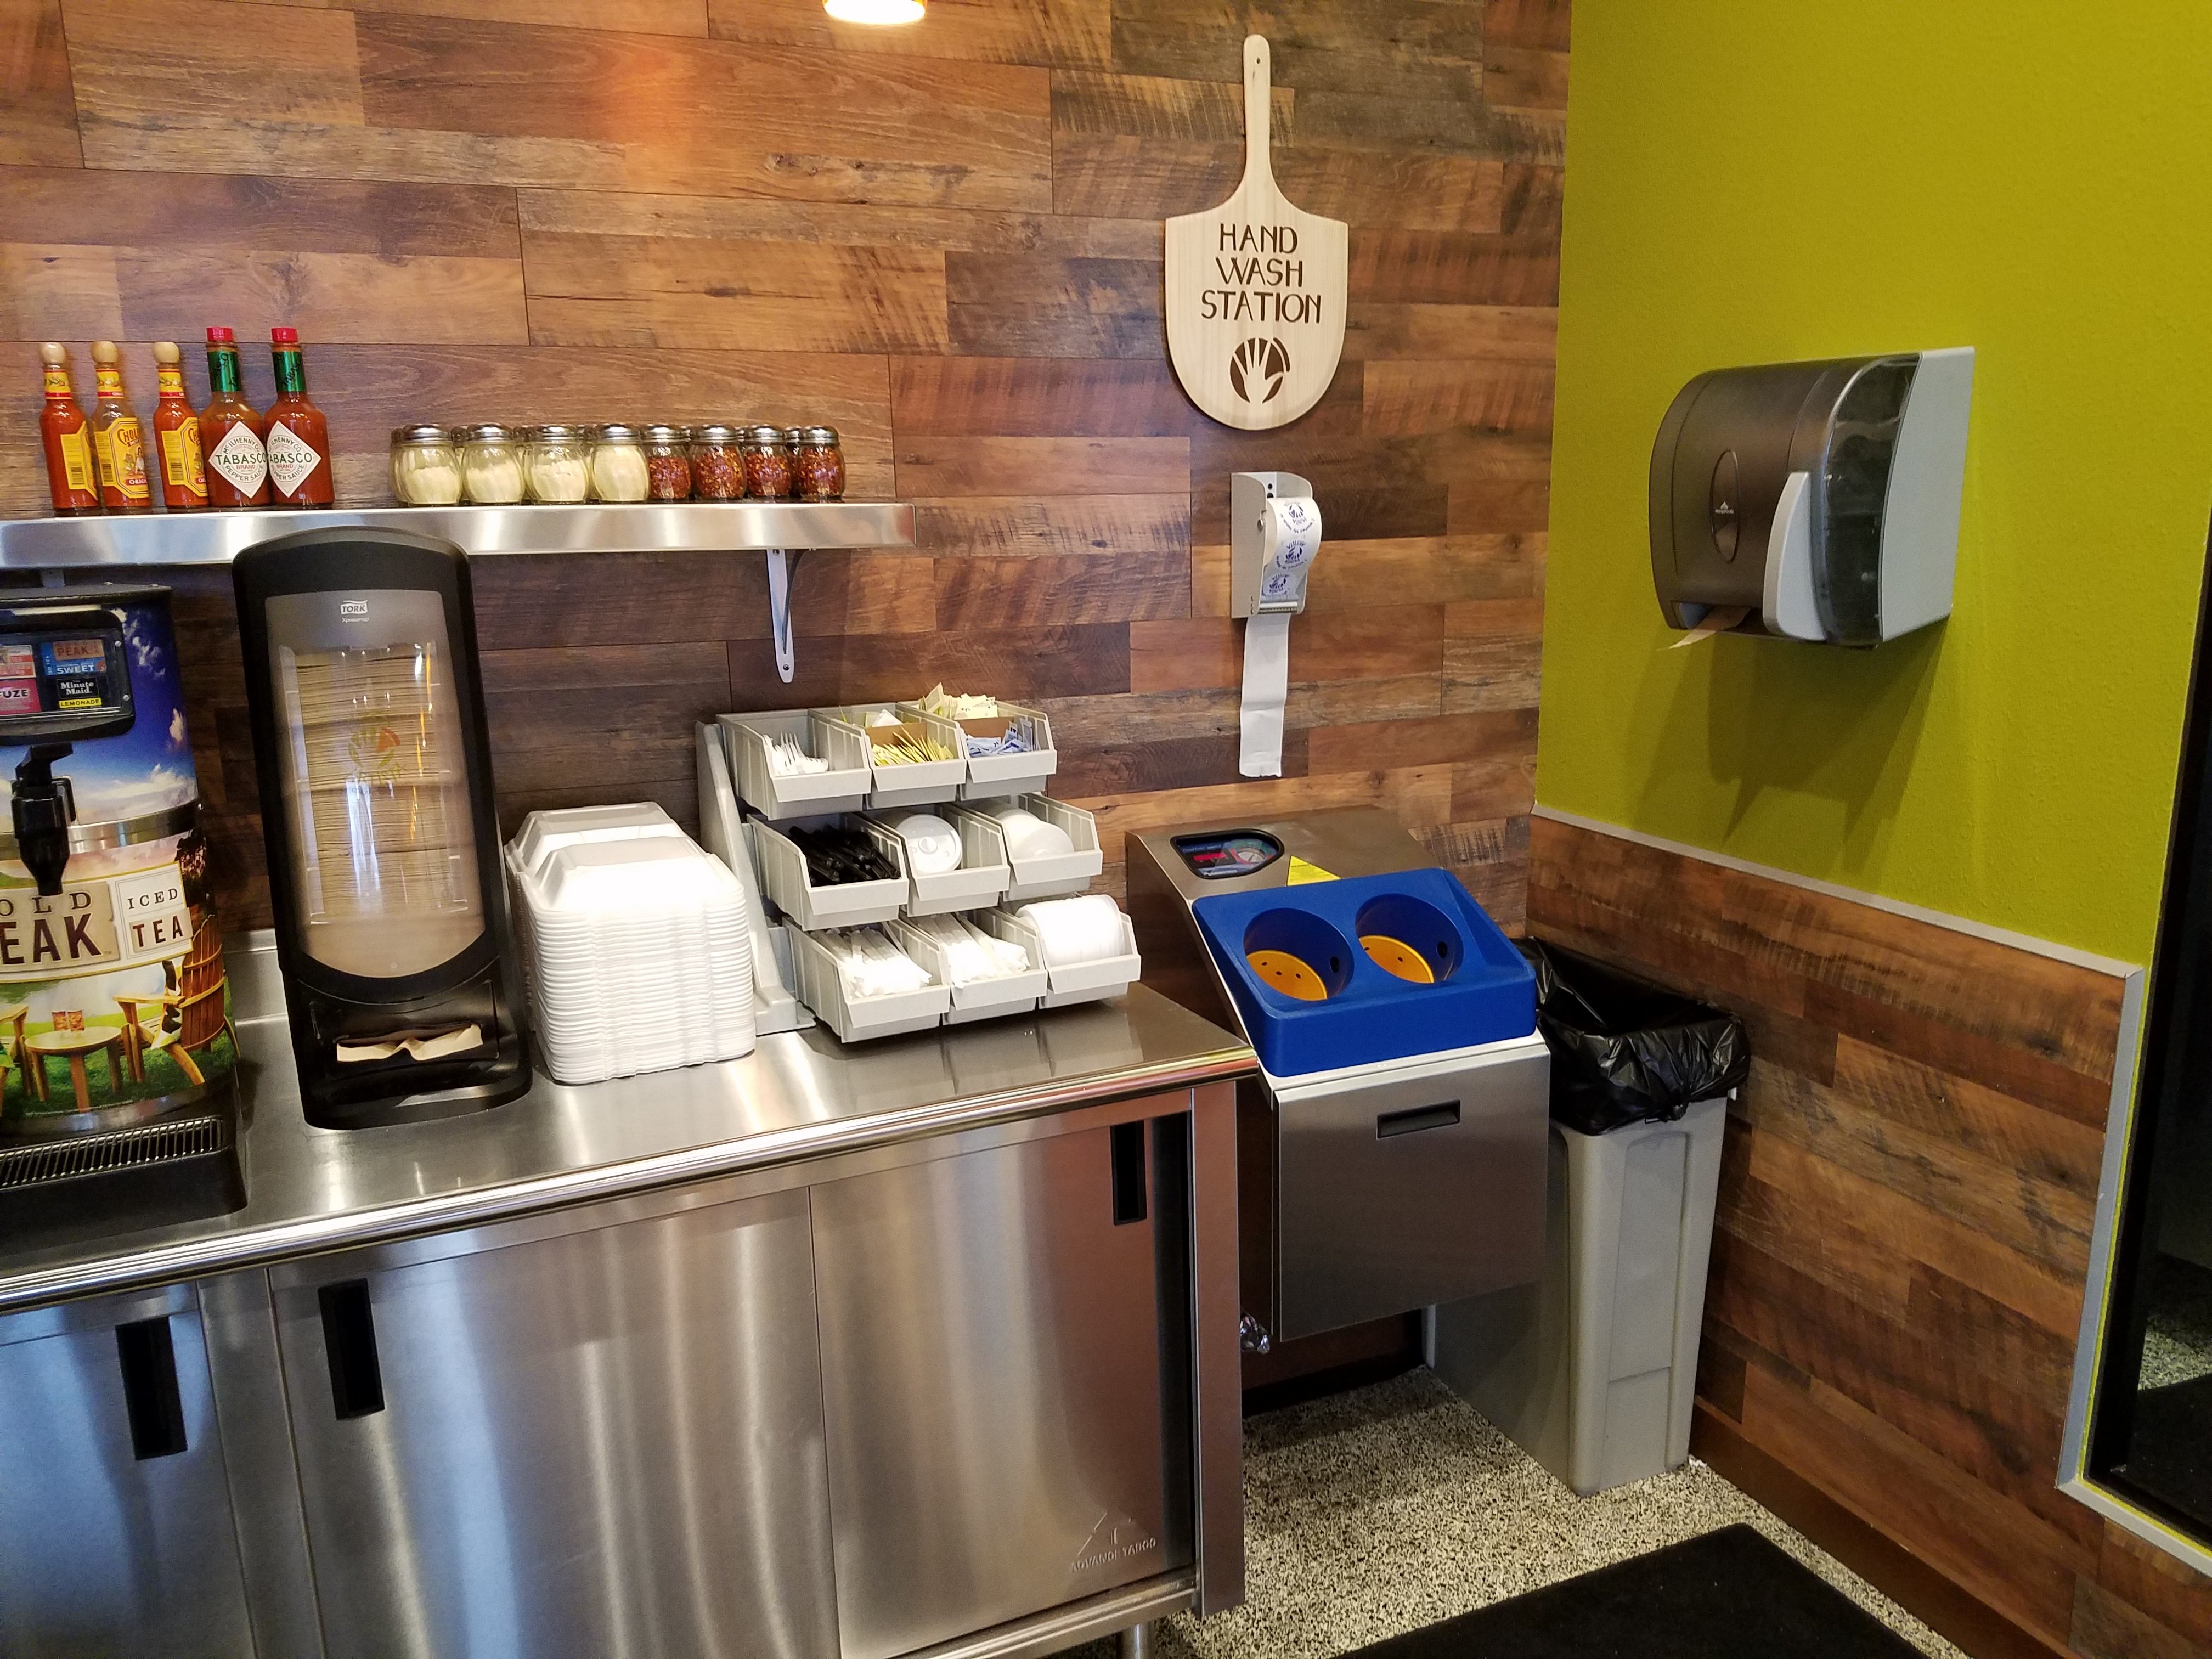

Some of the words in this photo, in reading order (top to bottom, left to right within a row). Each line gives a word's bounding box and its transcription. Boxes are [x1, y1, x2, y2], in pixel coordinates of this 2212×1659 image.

[1220, 223, 1298, 253] HAND
[1215, 257, 1303, 287] WASH
[1201, 289, 1322, 324] STATION
[215, 452, 266, 465] TABASCO
[224, 465, 249, 481] PEPPER
[287, 464, 304, 480] SAUCE
[58, 646, 89, 656] PEAK
[57, 664, 94, 674] SWEET
[66, 686, 91, 695] Maid
[127, 888, 178, 910] ICED
[132, 916, 184, 948] TEA
